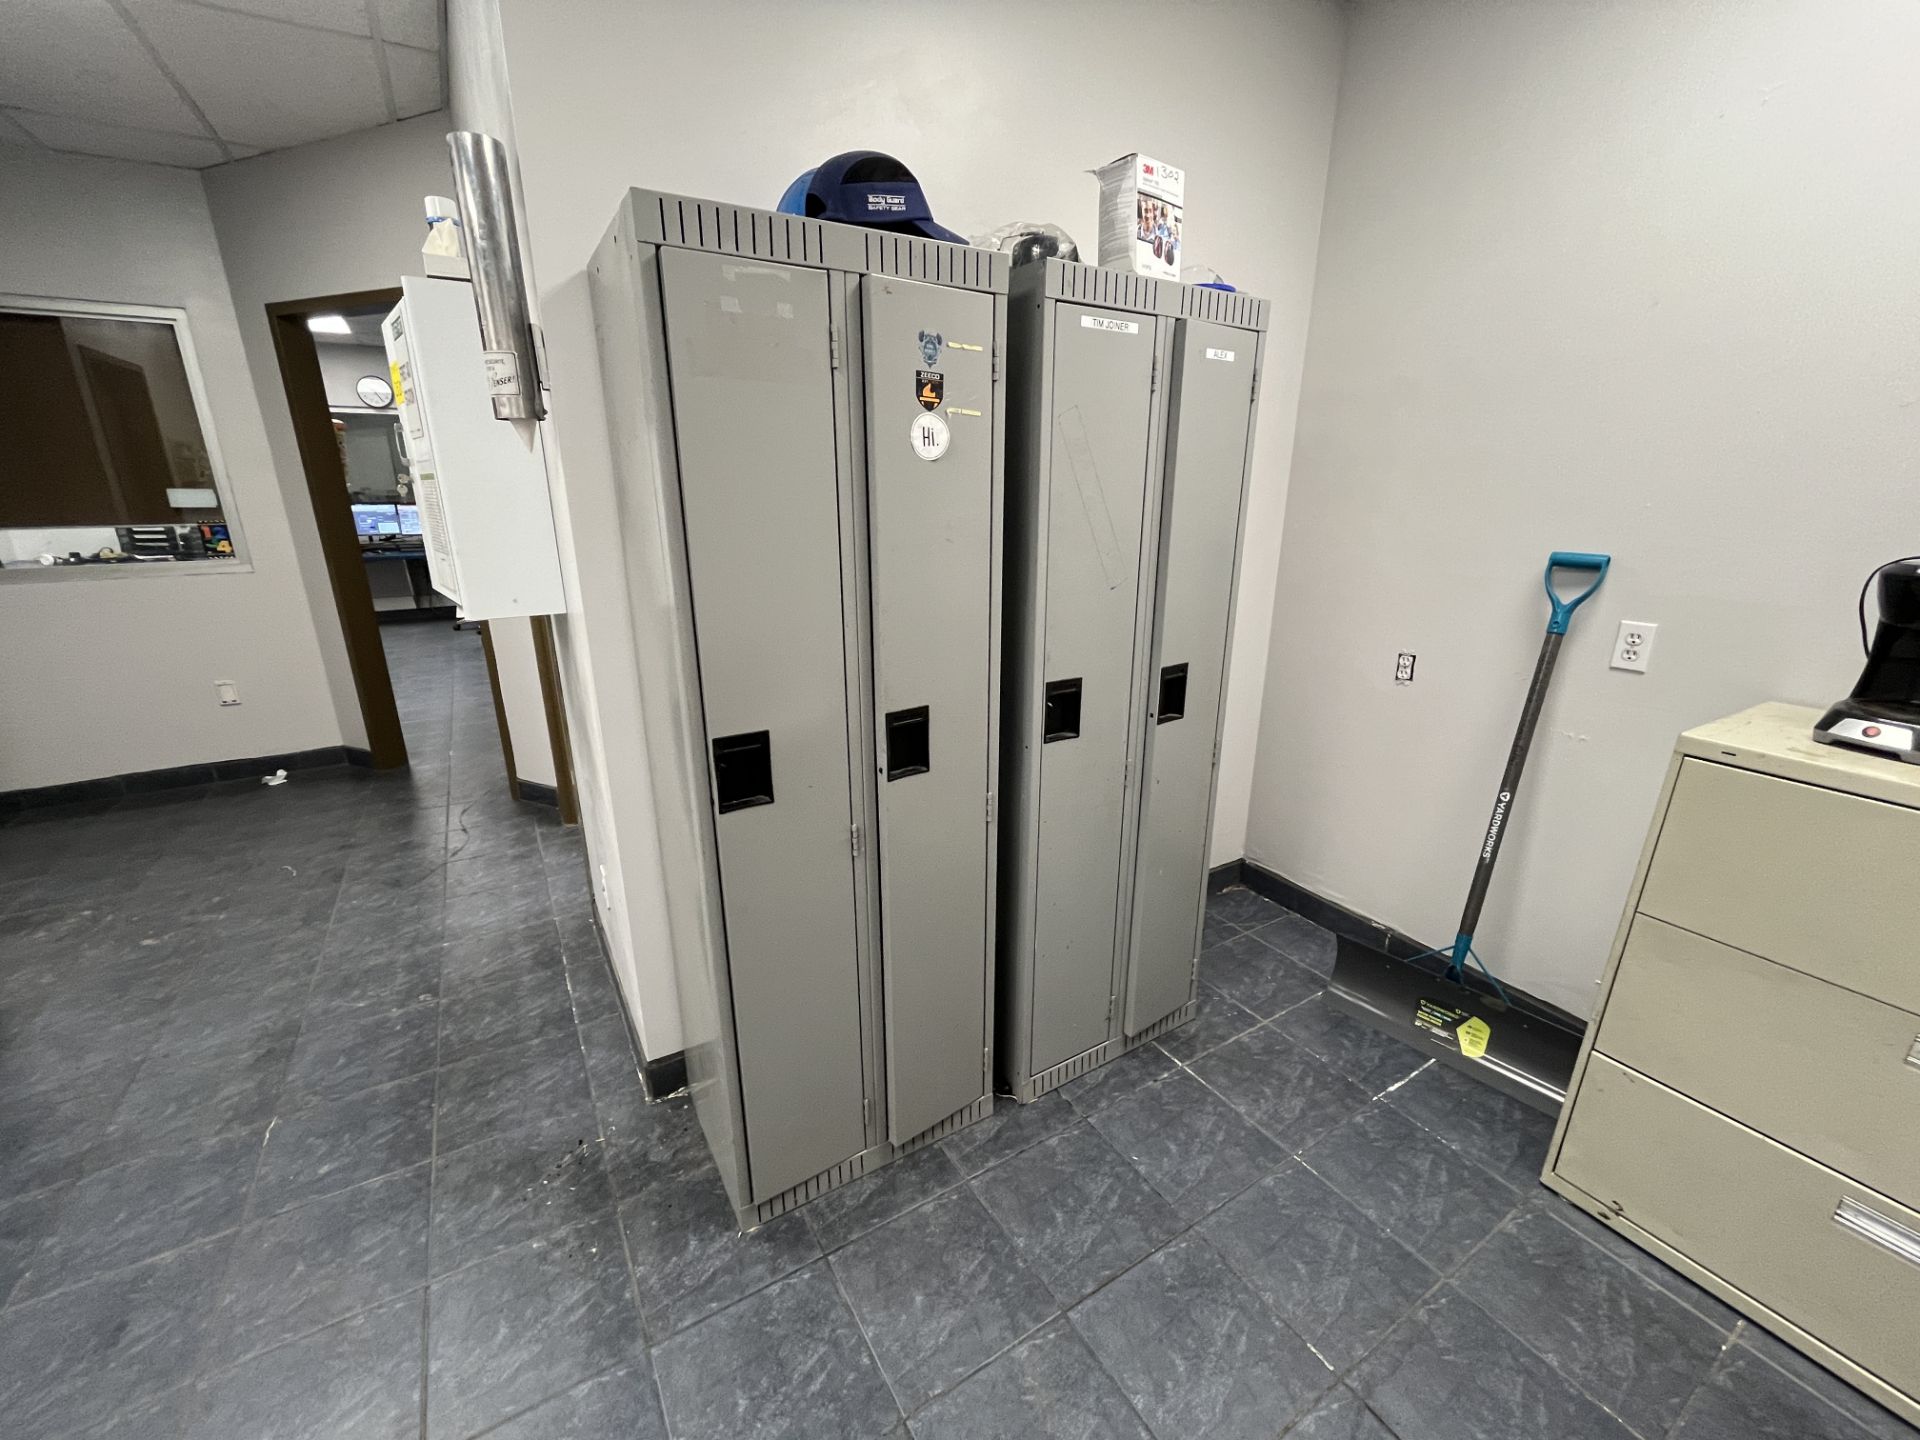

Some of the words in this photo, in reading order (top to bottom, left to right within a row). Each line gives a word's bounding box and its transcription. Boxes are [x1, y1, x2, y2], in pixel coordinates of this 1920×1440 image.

[1142, 163, 1154, 177] 3M
[1092, 319, 1104, 328] TIM
[1105, 320, 1129, 331] JOINER
[1213, 350, 1228, 360] ALEX
[920, 371, 940, 380] ZEECO
[922, 426, 939, 447] Hi.
[1482, 802, 1507, 858] YARDWORKS
